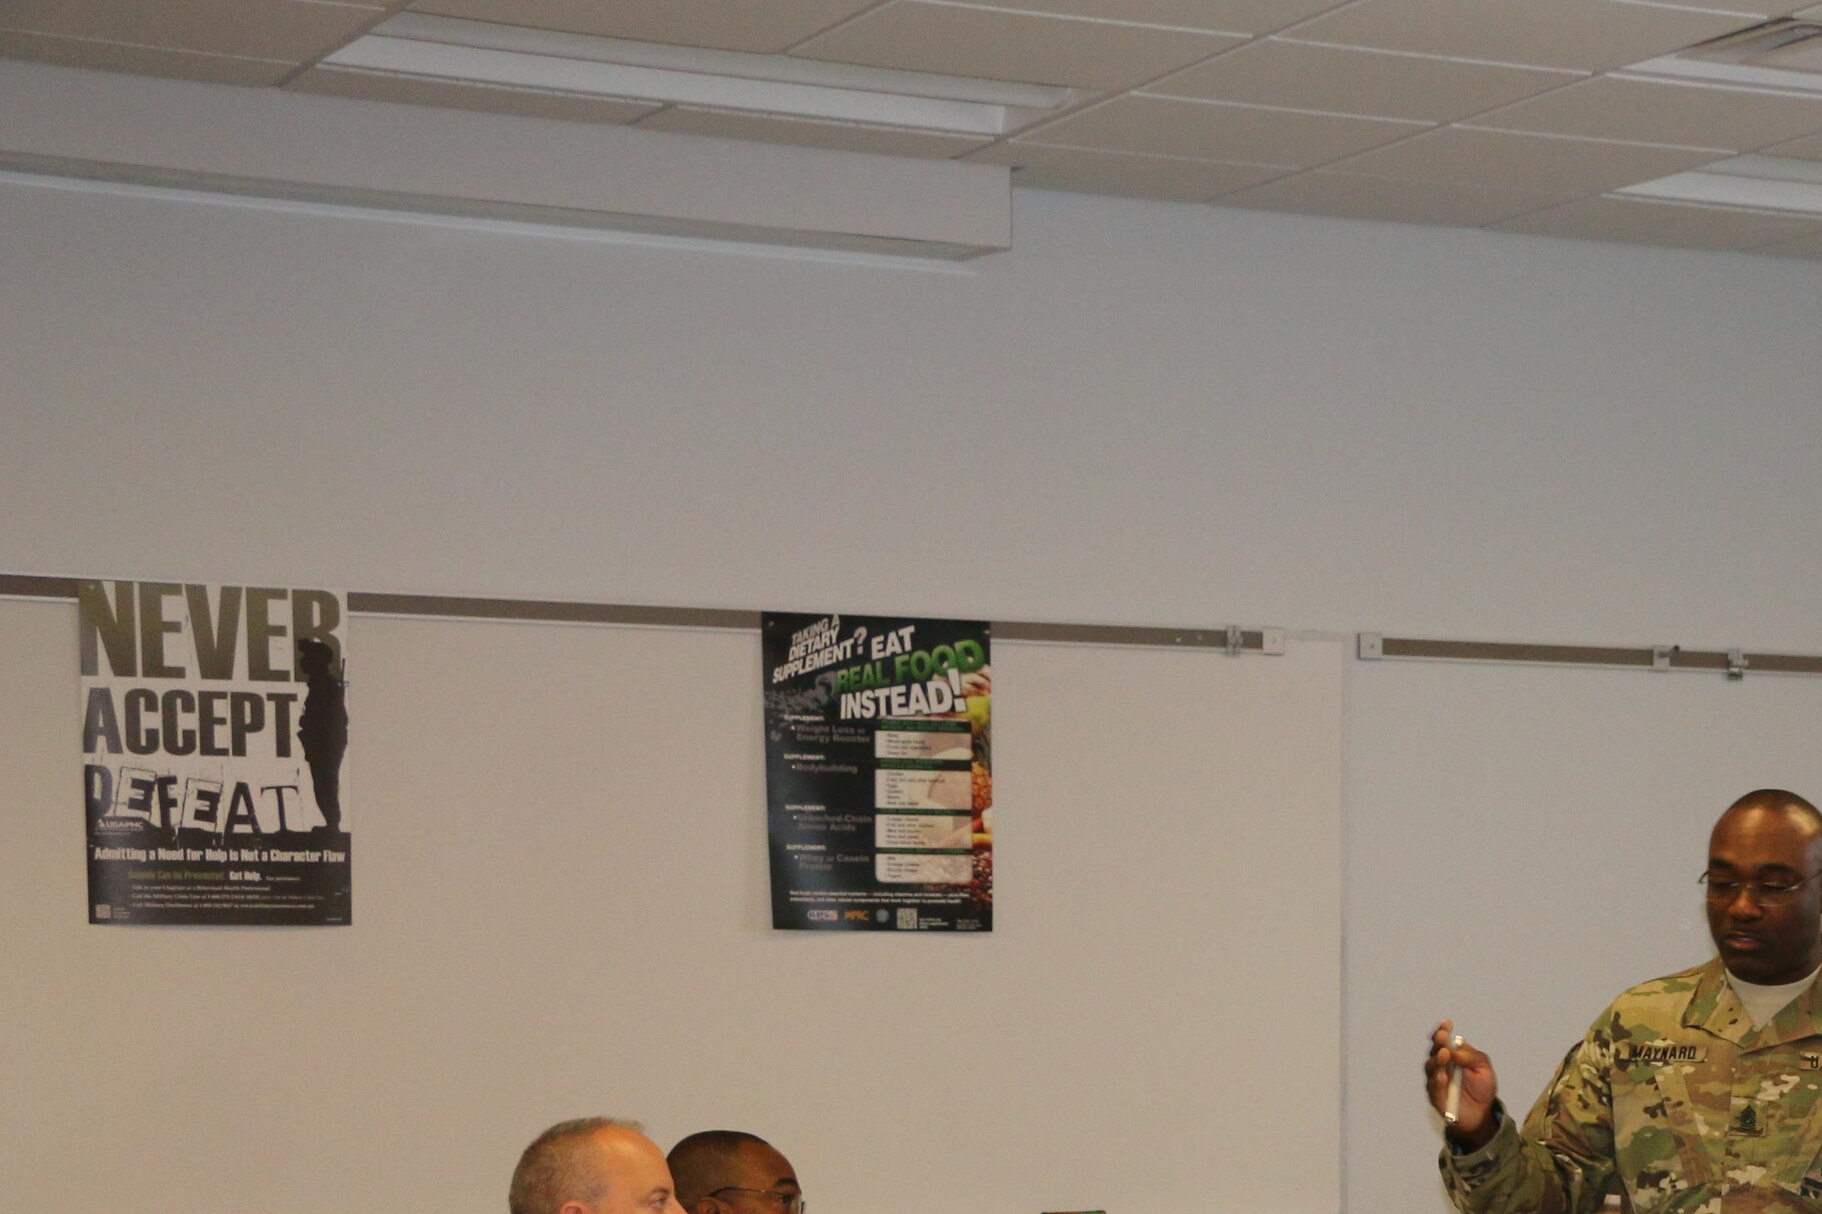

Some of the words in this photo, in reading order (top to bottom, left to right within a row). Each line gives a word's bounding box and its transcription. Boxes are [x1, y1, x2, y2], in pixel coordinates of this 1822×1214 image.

[78, 579, 342, 683] NEVER
[788, 626, 840, 661] DIETARY
[791, 617, 829, 645] TAKING
[831, 613, 840, 629] A
[871, 625, 915, 660] EAT
[772, 626, 868, 684] SUPPLEMENT?
[836, 660, 891, 692] REAL
[895, 639, 985, 681] FOOD
[840, 668, 968, 719] INSTEAD!
[83, 687, 298, 758] ACCEPT
[95, 847, 147, 862] Admitting
[158, 848, 184, 861] Need
[186, 848, 204, 861] for
[205, 848, 228, 863] Help
[241, 849, 260, 862] Not
[270, 849, 321, 862] Character
[323, 850, 346, 862] Flaw
[1632, 1045, 1697, 1060] MAYNARD
